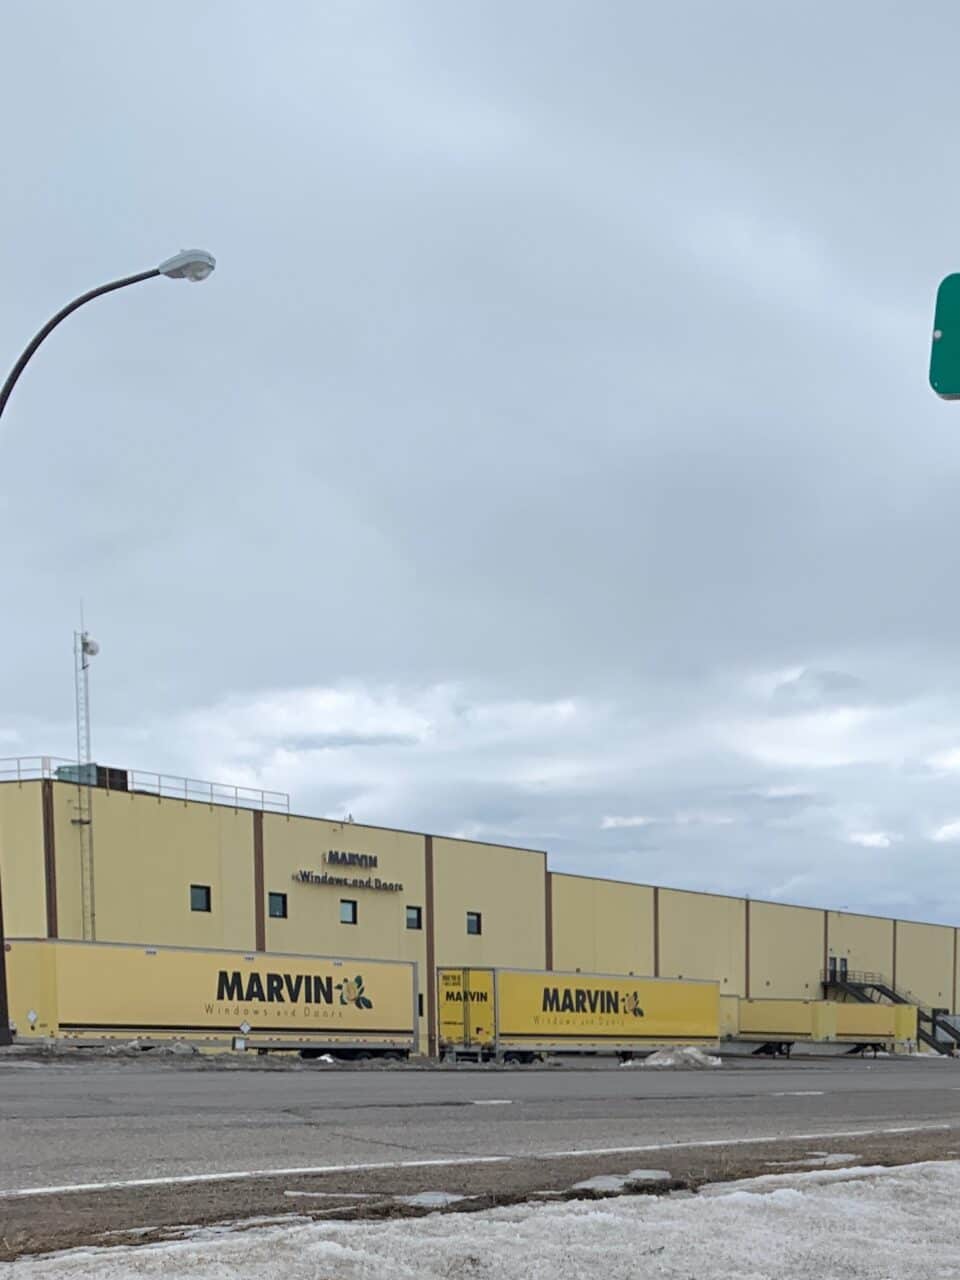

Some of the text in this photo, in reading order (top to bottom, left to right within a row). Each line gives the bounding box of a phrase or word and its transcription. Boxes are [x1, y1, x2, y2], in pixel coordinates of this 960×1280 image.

[327, 850, 378, 868] MARVIN
[216, 970, 333, 1004] MARVIN
[446, 991, 488, 1002] MARVIN
[541, 987, 619, 1013] MARVIN
